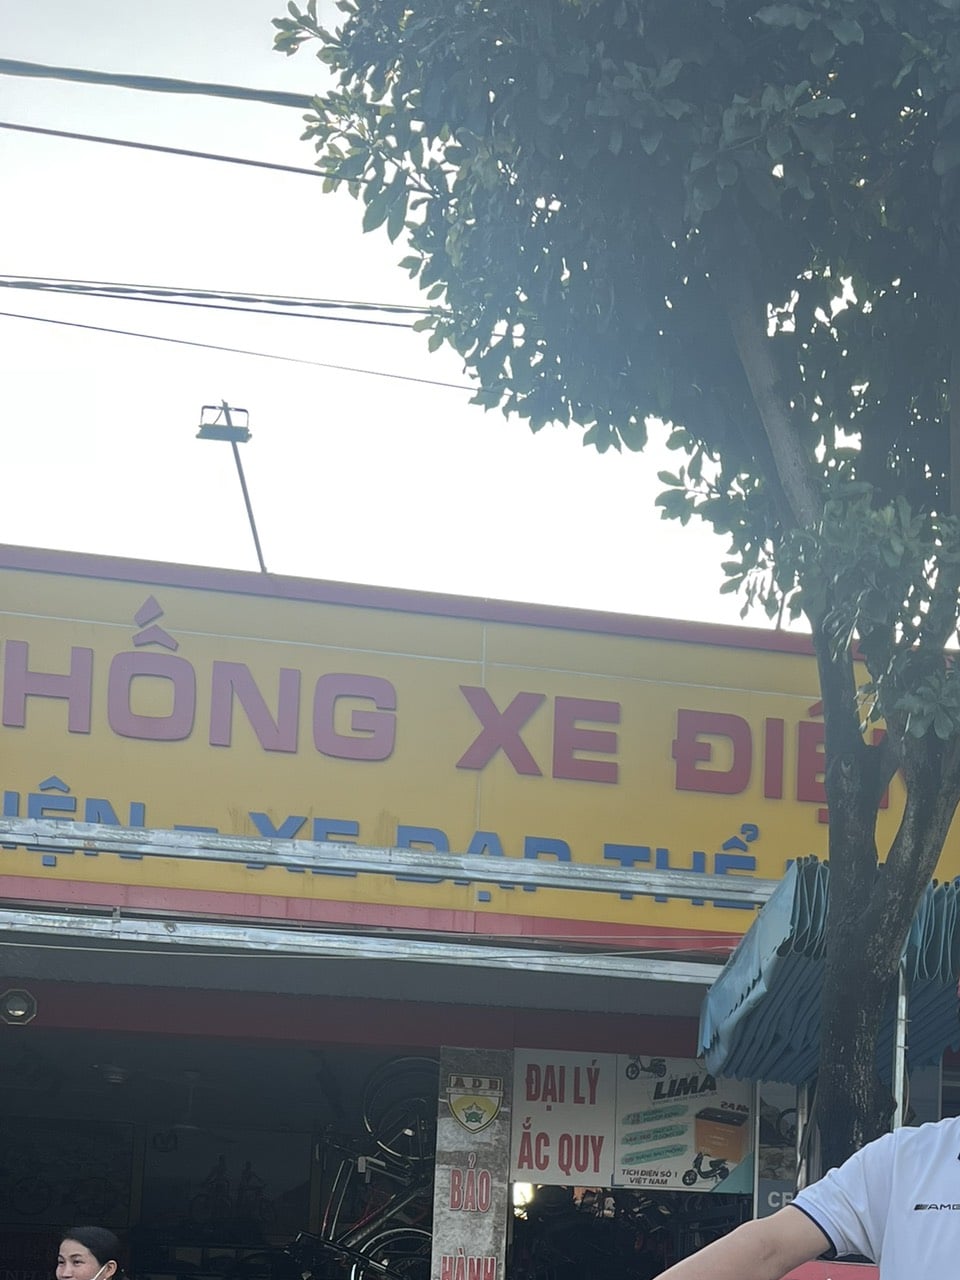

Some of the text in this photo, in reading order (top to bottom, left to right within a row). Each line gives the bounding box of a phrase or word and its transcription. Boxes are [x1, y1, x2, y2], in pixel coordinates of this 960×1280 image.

[455, 685, 622, 785] XE
[671, 699, 889, 824] ĐIỆ
[525, 1059, 601, 1112] ĐẠI LÝ
[653, 1073, 718, 1101] LIMA
[517, 1116, 551, 1172] ẮC
[557, 1132, 605, 1177] QUY
[449, 1151, 493, 1214] BẢO
